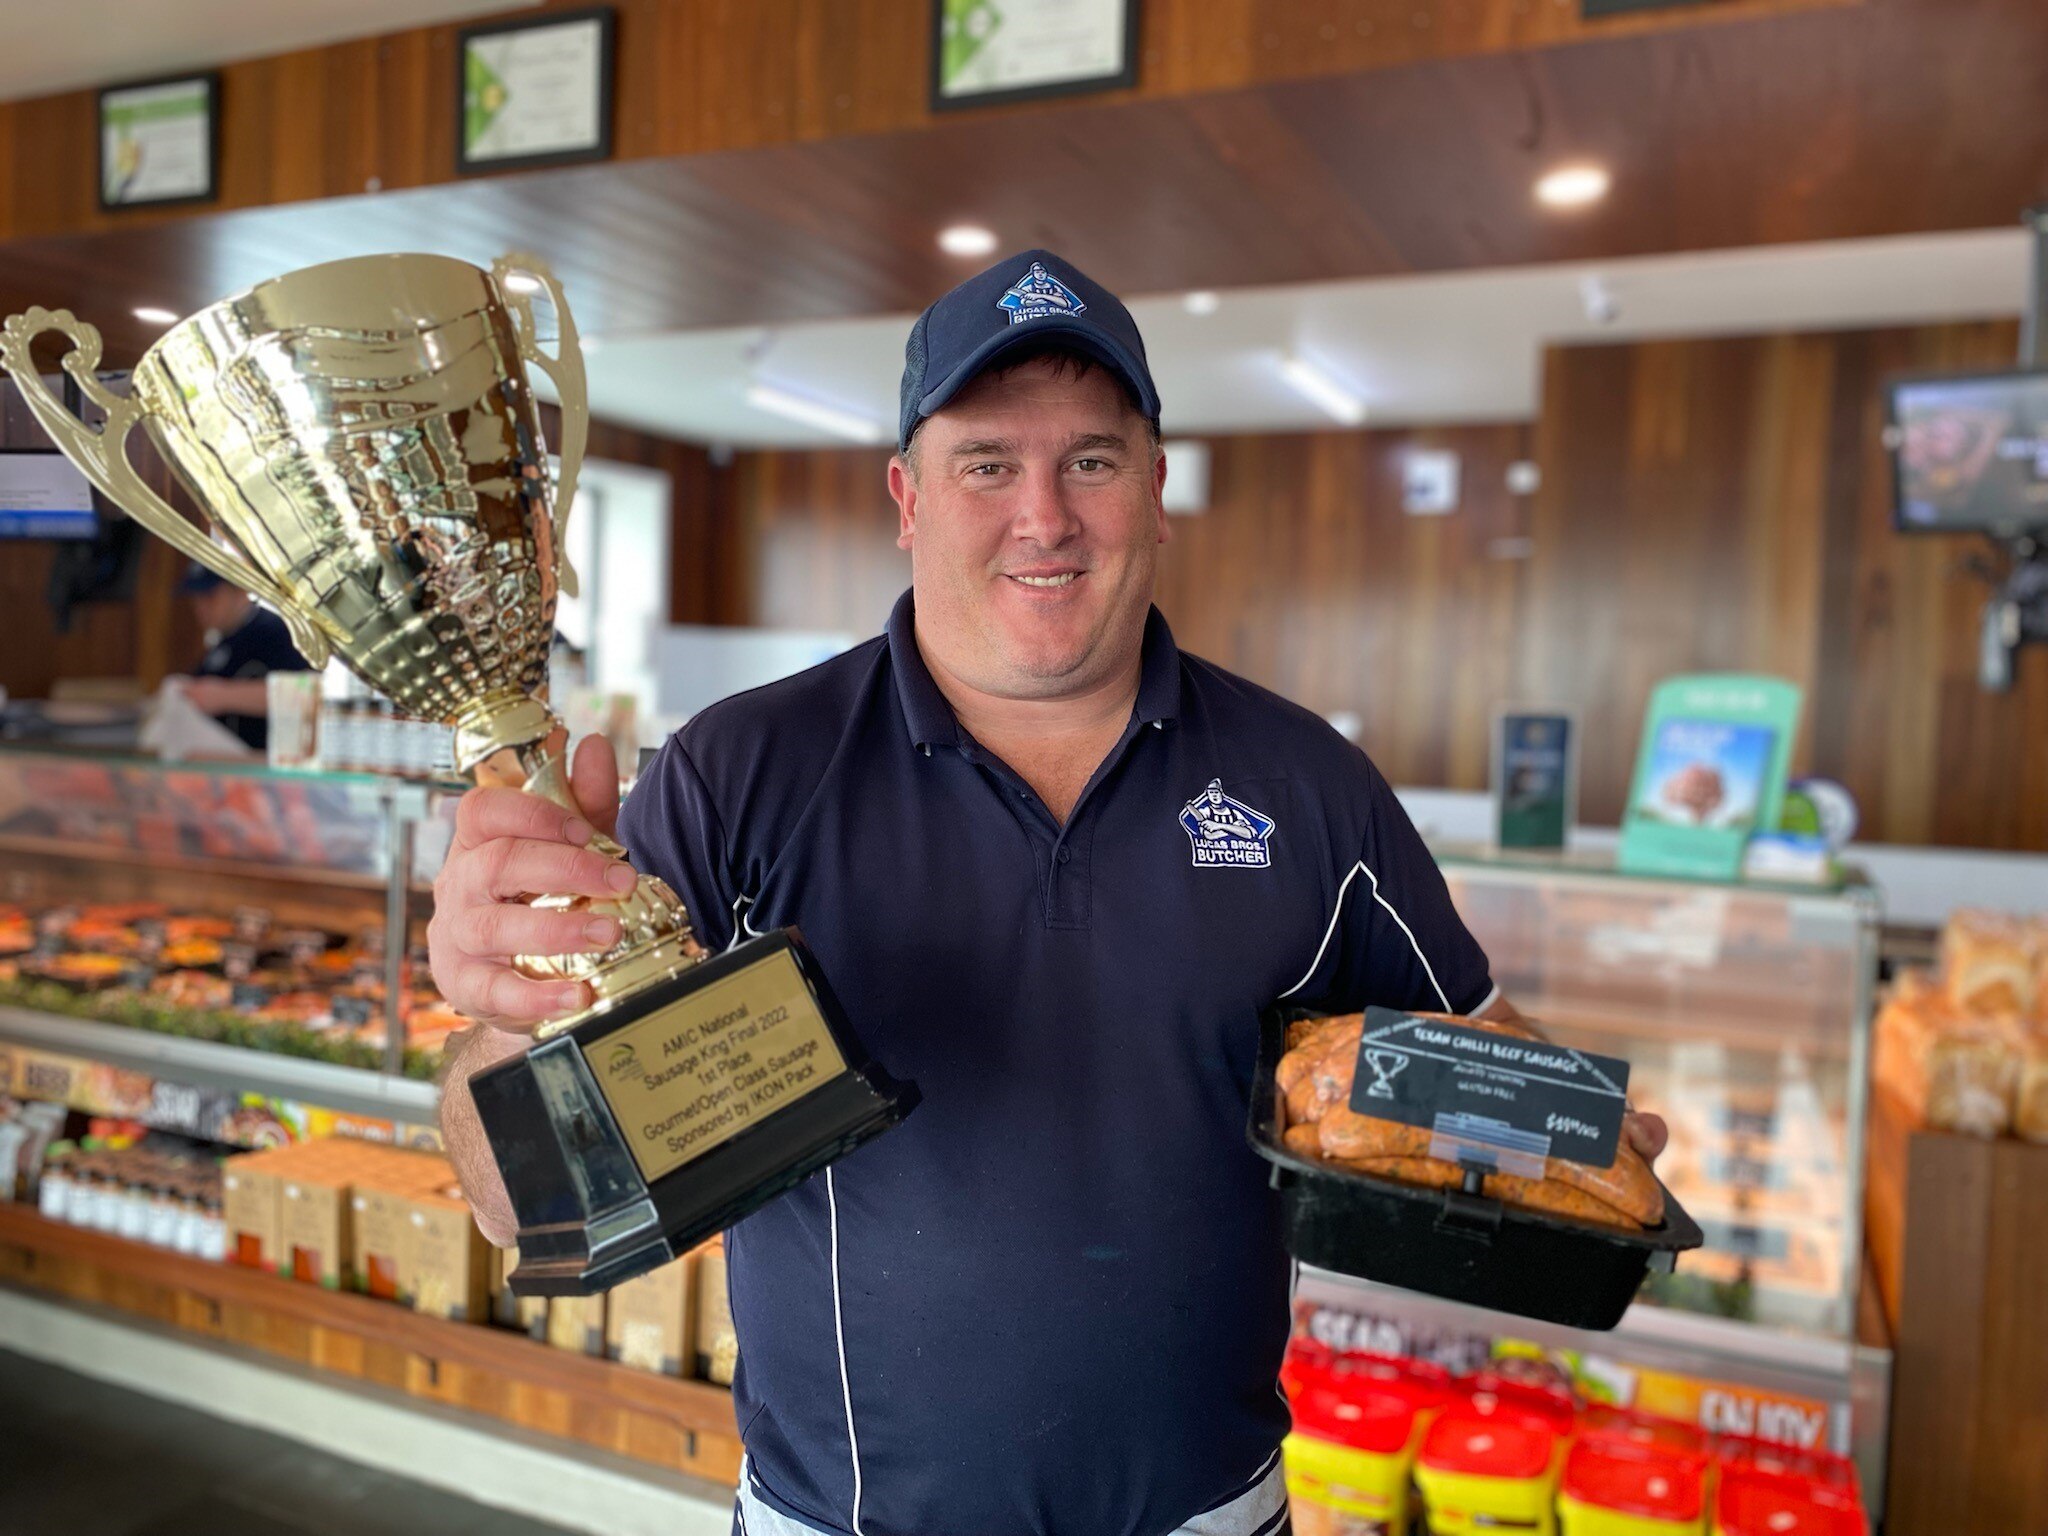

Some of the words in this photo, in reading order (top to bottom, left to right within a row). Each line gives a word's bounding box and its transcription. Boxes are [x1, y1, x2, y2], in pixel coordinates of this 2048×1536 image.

[1012, 306, 1047, 317] LUCAS
[1194, 837, 1229, 849] LUCAS
[1230, 839, 1265, 851] BROS.
[1196, 848, 1266, 863] BUTCHER
[643, 1055, 700, 1092] Sausage
[698, 1040, 731, 1062] King
[727, 1020, 759, 1046] Final
[758, 1005, 790, 1032] 2022
[662, 1027, 700, 1058] AMIC
[698, 1003, 749, 1038] National
[1452, 1035, 1492, 1054] CHILLI
[1490, 1042, 1524, 1061] BEEF
[697, 1067, 719, 1087] 1st
[716, 1050, 753, 1077] Place
[643, 1085, 735, 1141] Gourmet/Open
[733, 1066, 769, 1092] Class
[767, 1039, 819, 1073] Sausage
[667, 1105, 735, 1153] Sponsored
[733, 1099, 751, 1118] by
[749, 1078, 786, 1107] IKON
[784, 1062, 816, 1088] Pack
